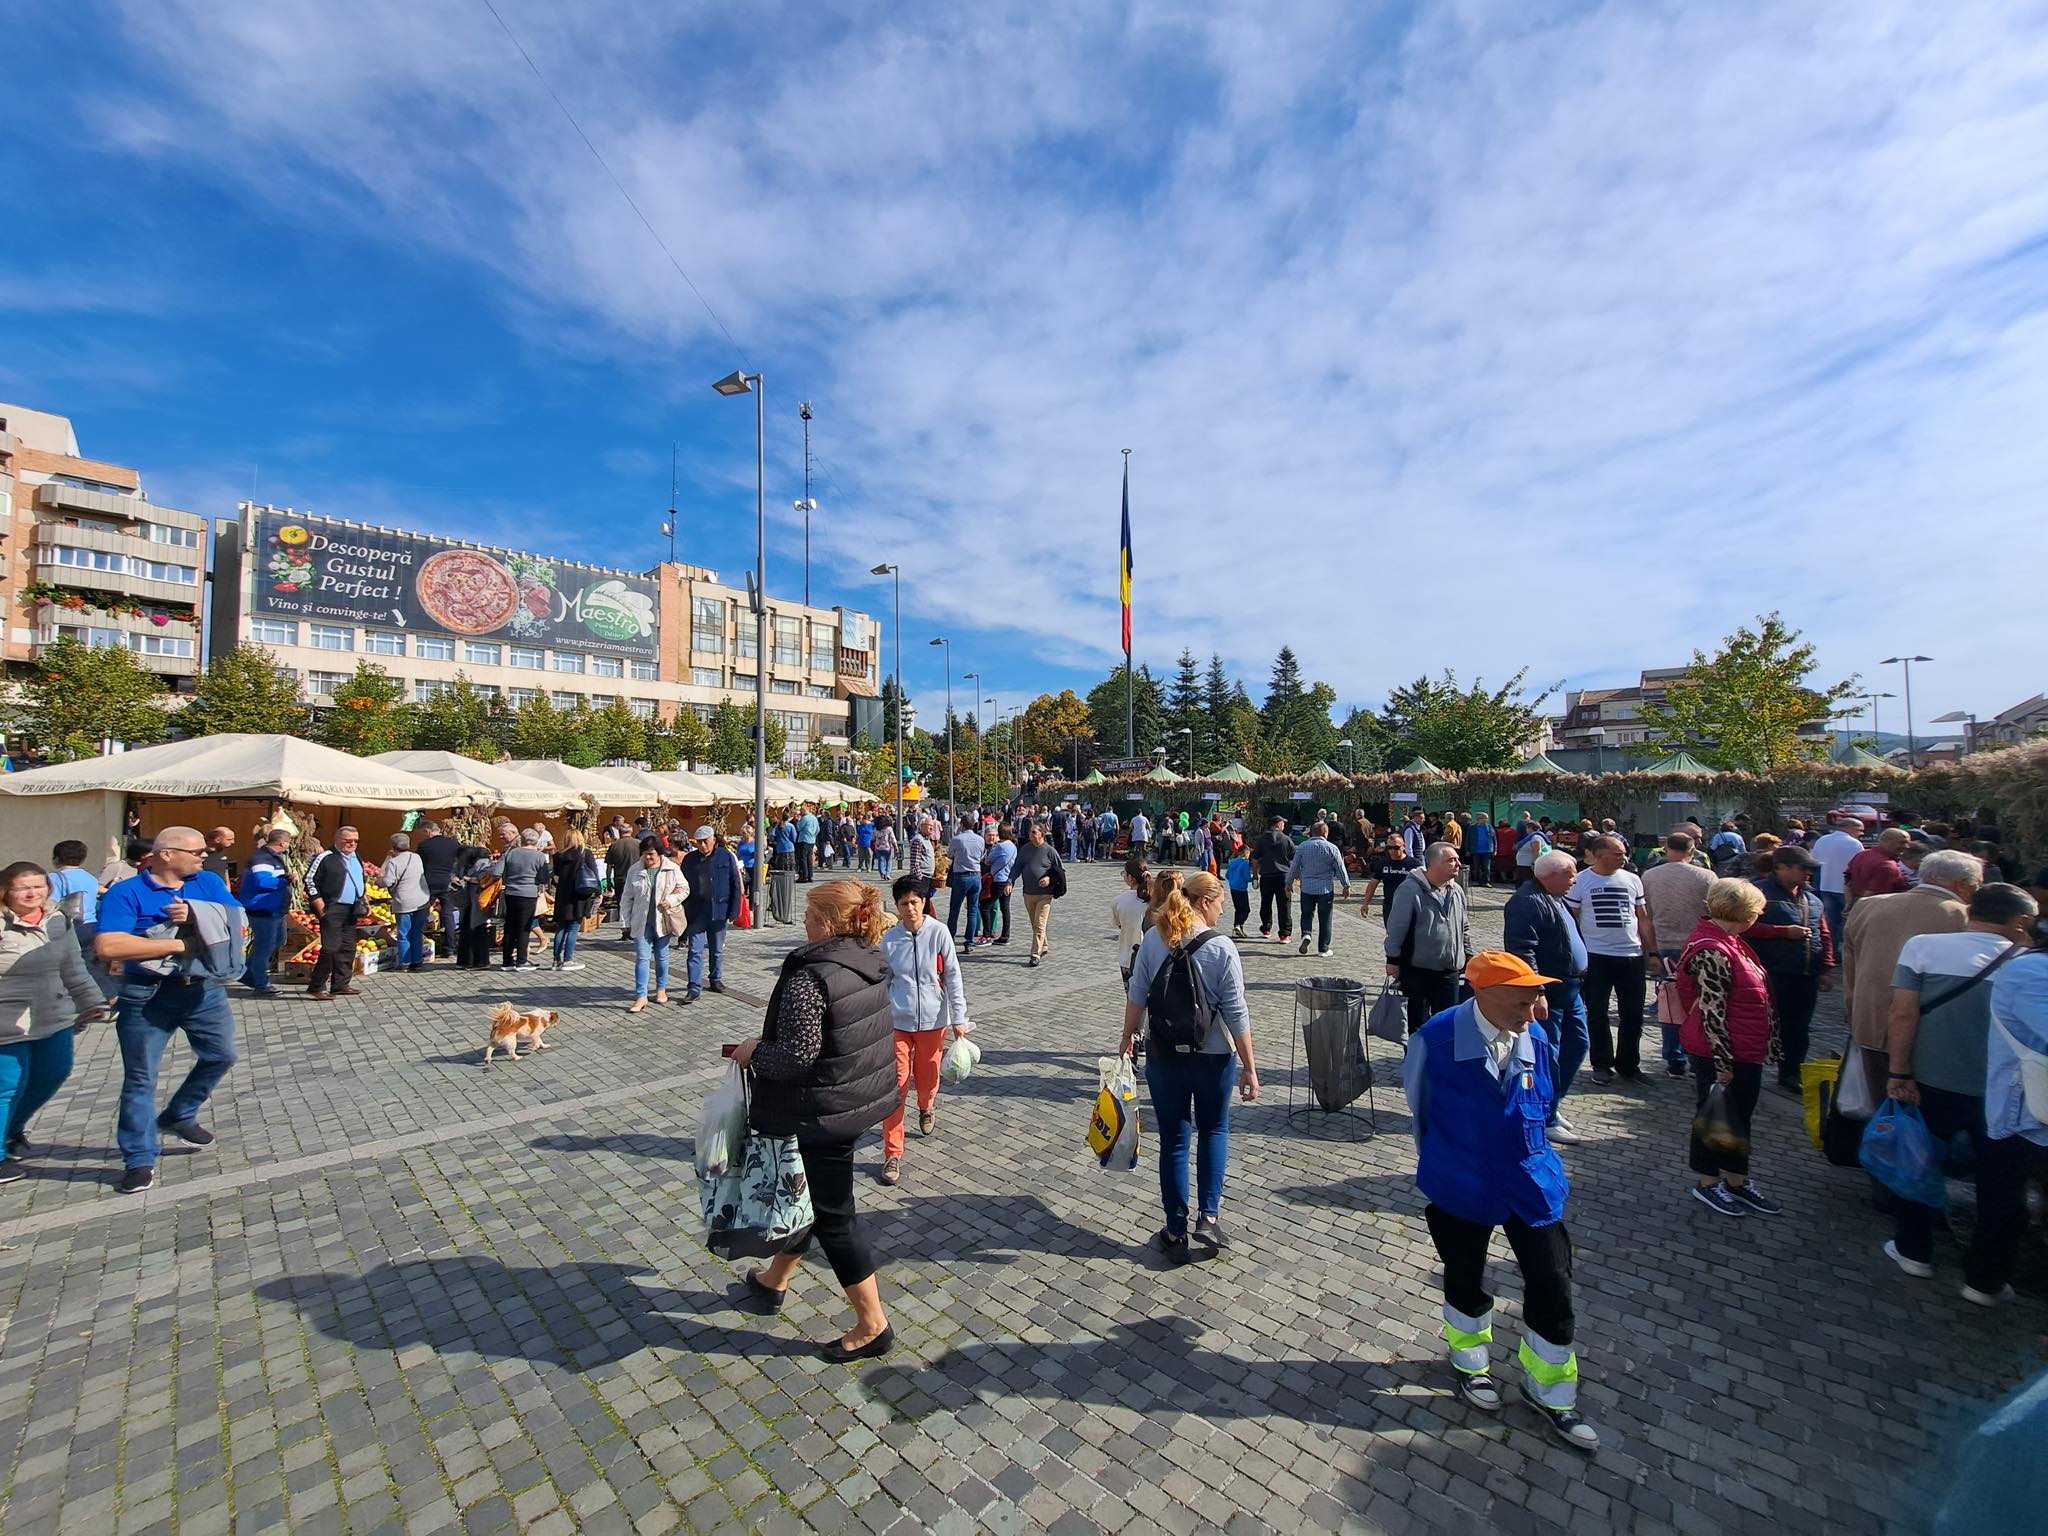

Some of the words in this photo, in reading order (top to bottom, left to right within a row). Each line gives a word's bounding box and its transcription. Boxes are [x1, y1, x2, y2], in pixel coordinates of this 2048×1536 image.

[308, 534, 413, 565] Descoperă
[327, 557, 396, 581] Gustul
[319, 575, 390, 599] Perfect
[267, 597, 299, 611] Vino
[316, 606, 387, 621] convinge-te!
[553, 587, 640, 635] Maestro
[555, 637, 653, 655] www.pizzeriamaestro.ro
